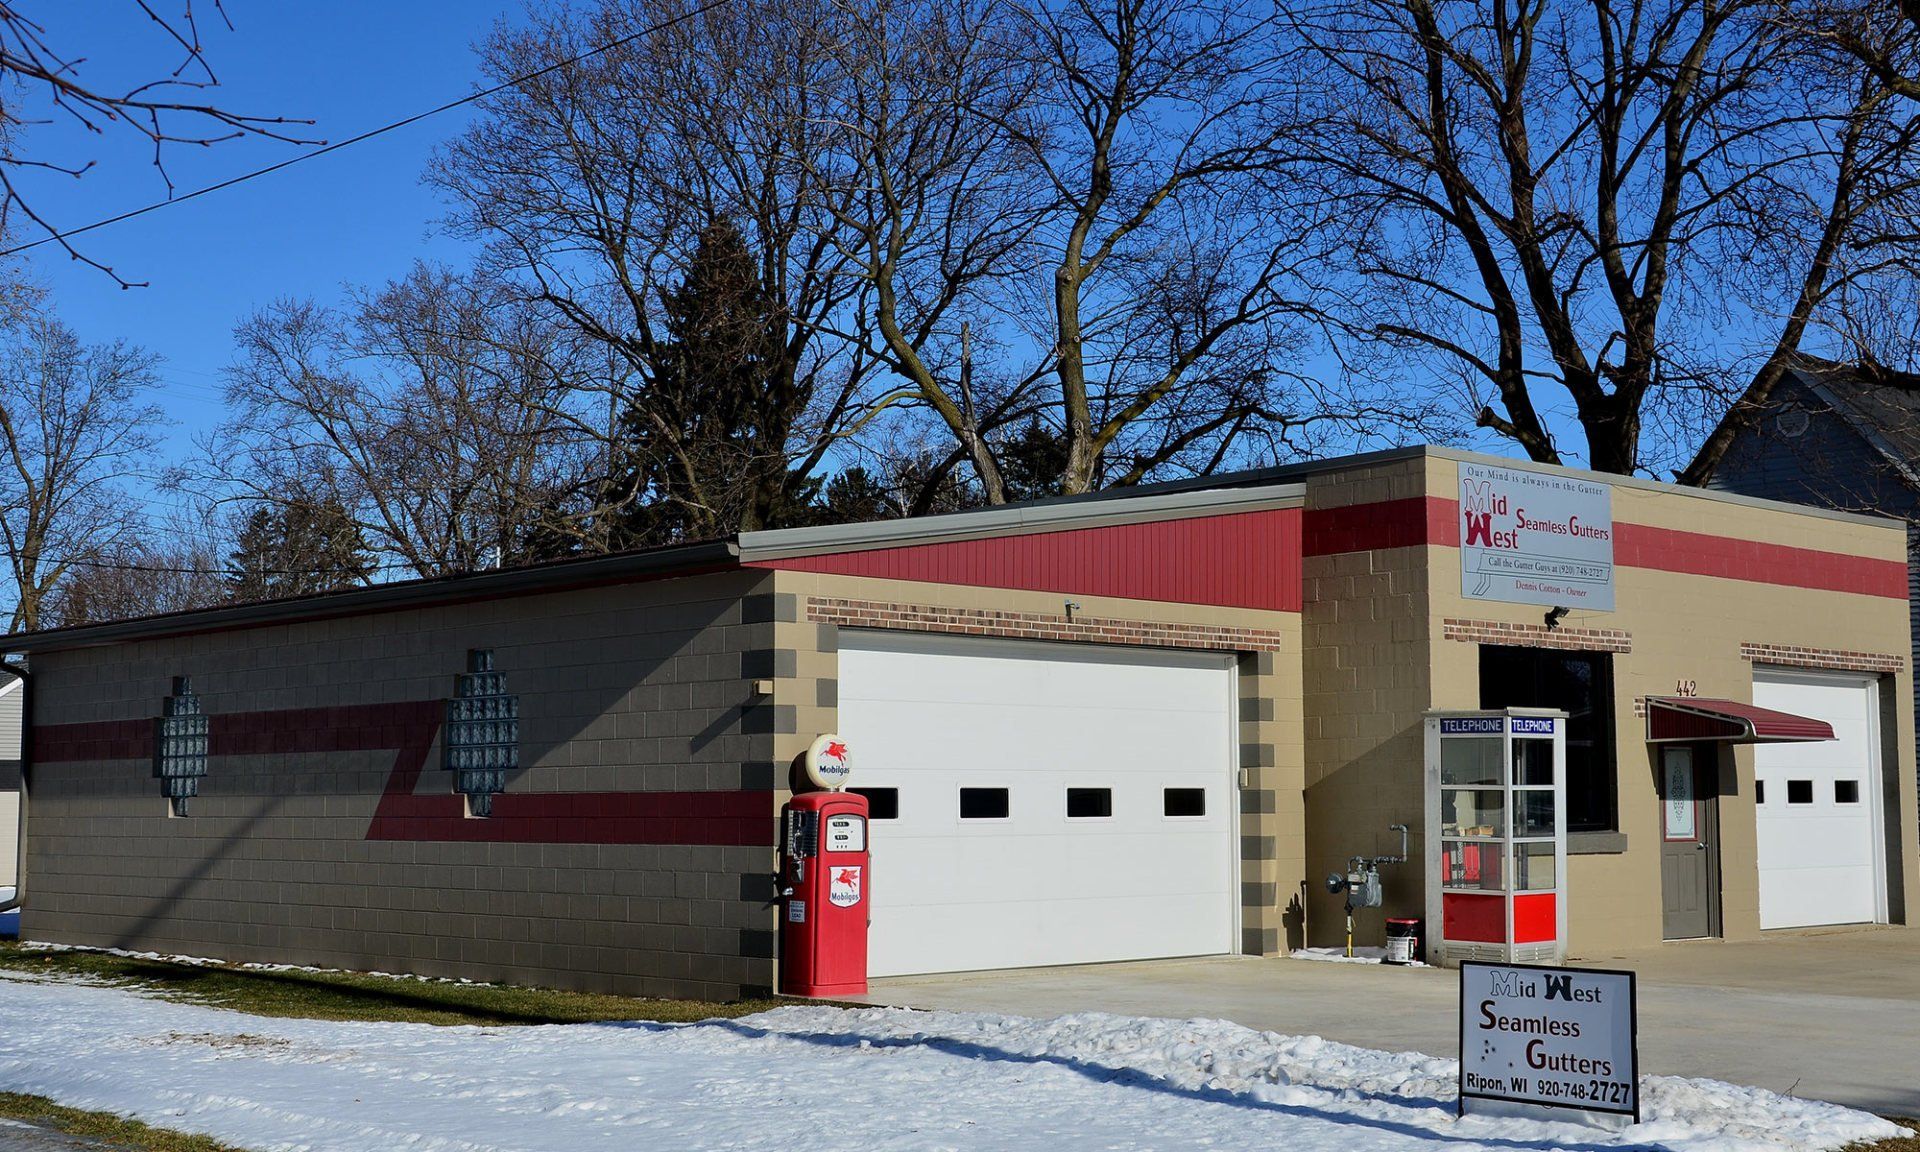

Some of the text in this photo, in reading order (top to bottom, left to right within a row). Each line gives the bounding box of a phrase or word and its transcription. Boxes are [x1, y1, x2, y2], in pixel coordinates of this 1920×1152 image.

[1467, 466, 1603, 496] Our Mind is always in the Gutter
[1463, 478, 1508, 516] Mid
[1465, 511, 1518, 549] West
[1516, 508, 1609, 541] Seamless Gutters
[1488, 557, 1501, 567] Call
[1502, 558, 1513, 568] the
[1514, 560, 1533, 570] Gutter
[1535, 561, 1551, 574] Guys
[1558, 564, 1575, 575] (920)
[1576, 566, 1603, 578] 748-2727
[1515, 579, 1538, 591] Dennis
[1566, 586, 1587, 597] Owner
[1675, 680, 1697, 697] 442
[1444, 720, 1502, 732] TELEPHONE
[1512, 719, 1553, 733] TELEPHONE
[819, 765, 850, 776] Mobilgas
[831, 891, 859, 903] Mobilgas
[1490, 970, 1602, 1003] Mid West
[1479, 1000, 1581, 1038] Seamless
[1525, 1039, 1612, 1077] Gutters
[1466, 1072, 1631, 1104] Ripon, WI 920-748-2727
